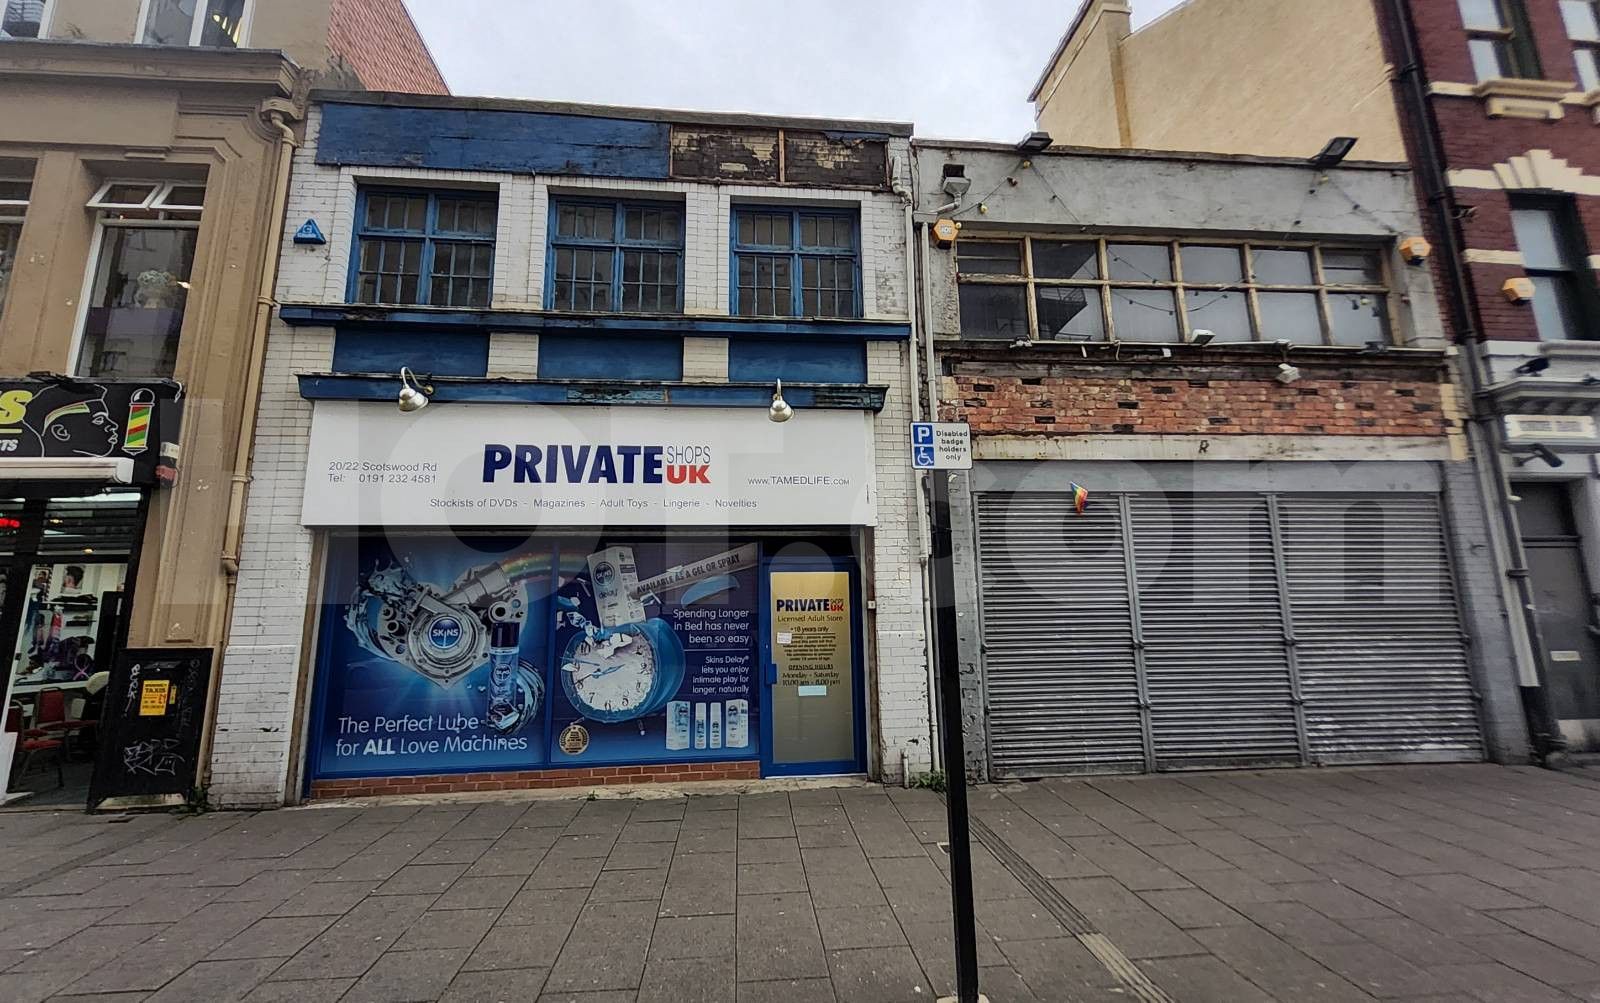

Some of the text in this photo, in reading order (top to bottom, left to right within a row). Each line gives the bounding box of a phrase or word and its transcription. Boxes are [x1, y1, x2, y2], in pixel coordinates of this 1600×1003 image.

[917, 426, 930, 443] P
[945, 453, 961, 461] only
[328, 461, 438, 472] 20/22 Scotswood Rd
[482, 443, 711, 484] PRIVATE SHOPS
[327, 473, 437, 484] Tel: 0191 232 4581
[666, 464, 712, 484] UK
[430, 498, 474, 508] Stockists
[477, 498, 487, 508] of
[489, 499, 518, 508] DVDs
[533, 499, 586, 510] Magazines
[600, 499, 625, 508] Adult
[627, 499, 649, 510] Toys
[662, 499, 701, 510] Lingerie
[715, 499, 758, 508] Novelties
[637, 575, 673, 593] AVAILABLE
[692, 566, 705, 577] GEL
[705, 562, 716, 572] OR
[717, 553, 740, 569] SPRAY
[776, 599, 830, 612] PRIVATE
[673, 608, 750, 620] Spending Longer
[778, 614, 844, 623] Licensed Adult Store
[674, 621, 750, 631] in Bed has never
[431, 628, 460, 638] SKINS
[688, 633, 750, 645] been so easy
[705, 655, 724, 664] Skins
[702, 665, 750, 675] lets you enjoy
[782, 672, 808, 680] Monday
[814, 670, 841, 679] Saturday
[722, 675, 738, 685] play
[739, 674, 750, 683] for
[692, 684, 750, 696] longer, naturally
[338, 712, 479, 734] The Perfect Lube
[336, 734, 529, 757] for ALL Love Machines
